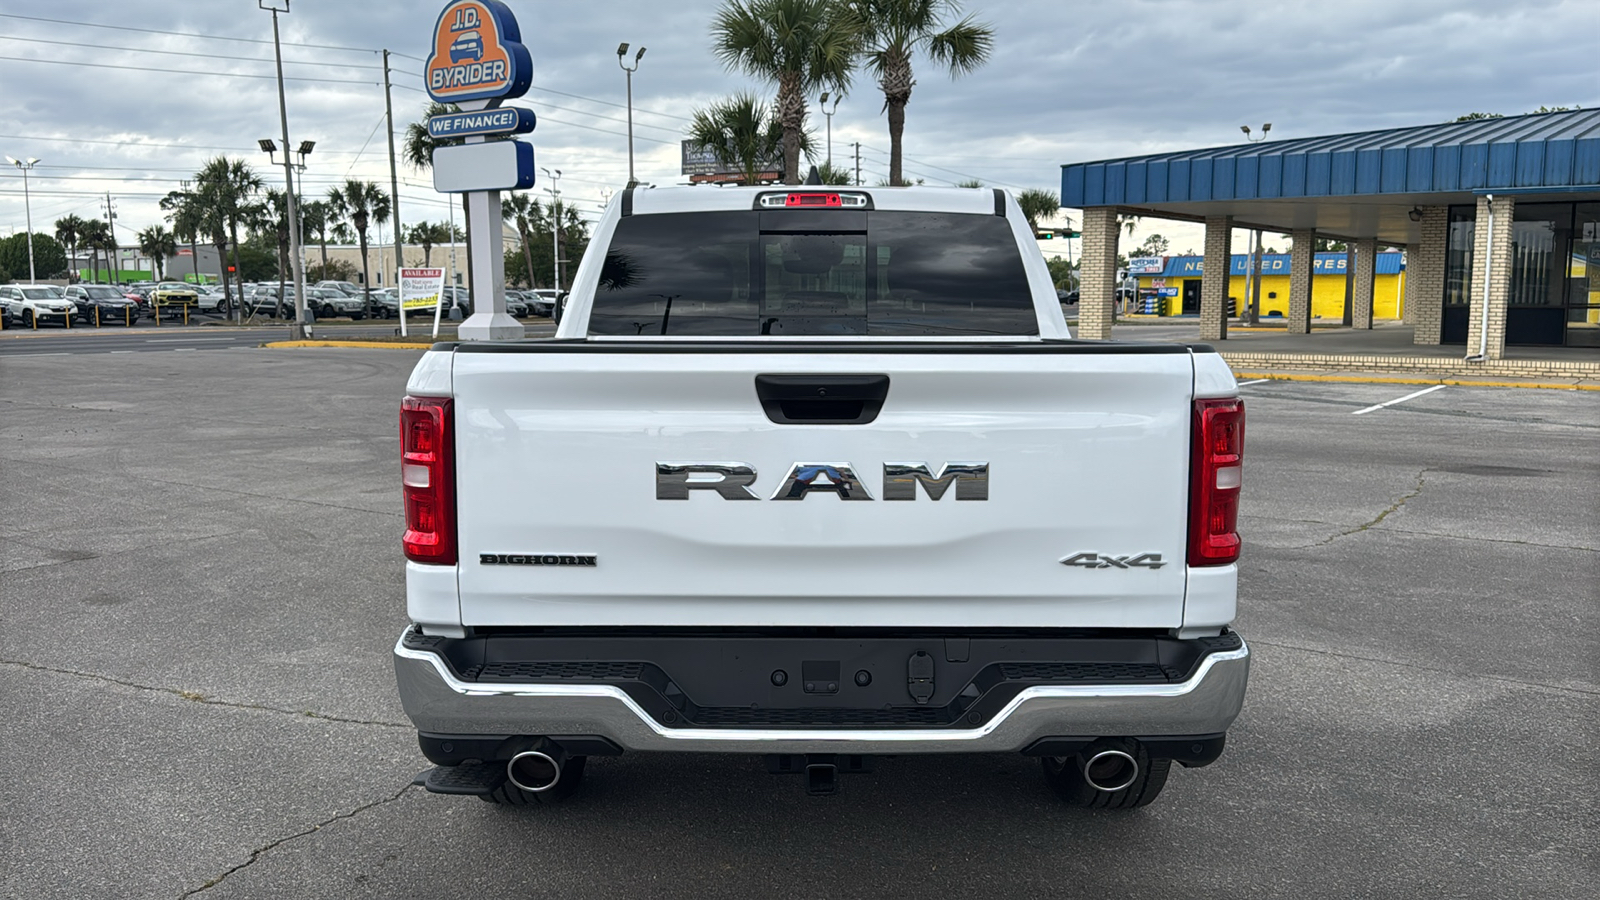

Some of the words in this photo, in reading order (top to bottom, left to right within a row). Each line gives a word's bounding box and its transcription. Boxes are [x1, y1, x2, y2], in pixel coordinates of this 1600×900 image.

[450, 7, 481, 32] J.D.
[431, 60, 506, 90] BYRIDER
[432, 119, 452, 132] WE
[454, 113, 513, 130] FINANCE!
[1185, 262, 1204, 270] NE
[656, 461, 989, 500] RAM
[480, 553, 597, 566] BIGHORN
[1060, 551, 1167, 569] 4x4
